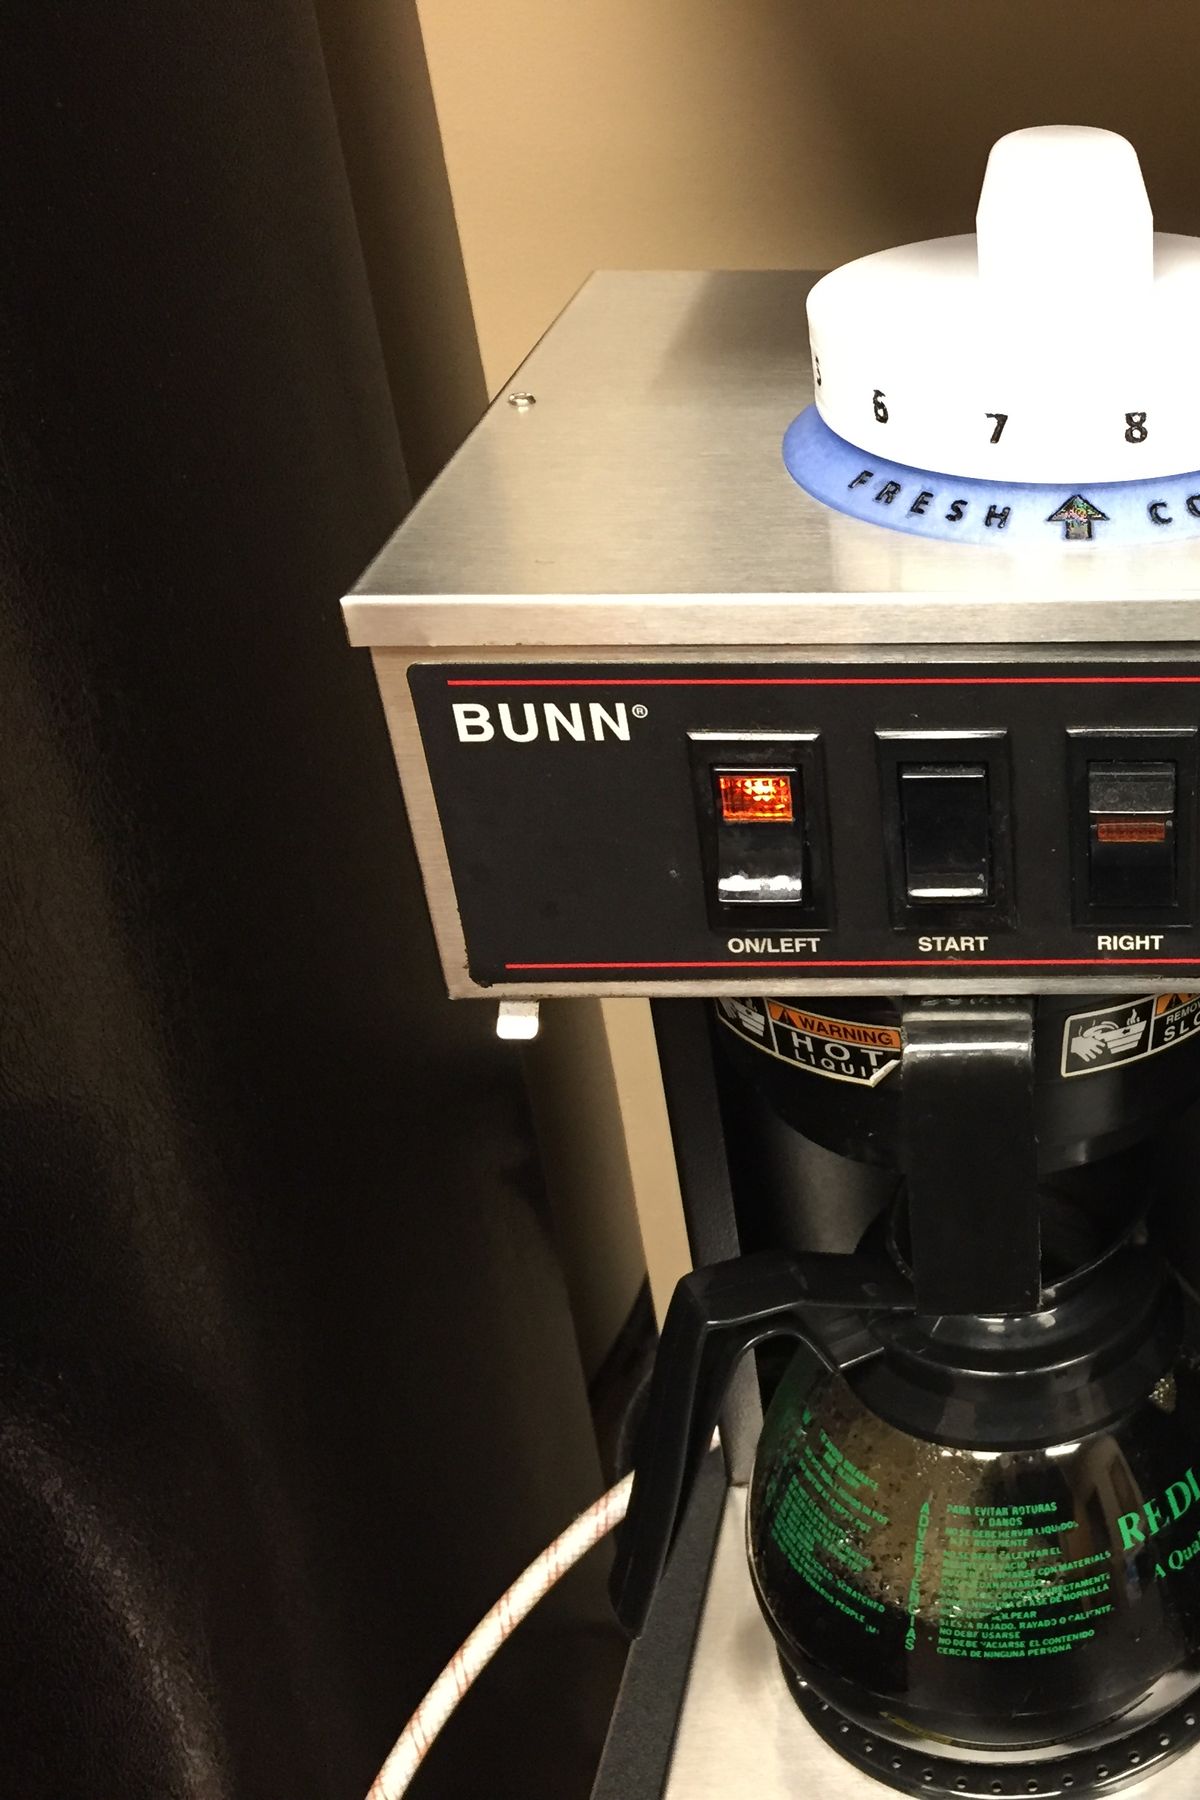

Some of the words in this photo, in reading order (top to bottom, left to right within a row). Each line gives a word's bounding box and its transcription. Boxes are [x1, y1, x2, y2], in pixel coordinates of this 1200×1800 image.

[872, 389, 889, 424] 6
[984, 412, 1009, 444] 7
[1125, 412, 1148, 444] 8
[847, 470, 1012, 529] FRESH
[727, 936, 820, 955] ON/LEFT
[917, 936, 989, 954] START
[1095, 935, 1165, 953] RIGHT
[798, 1015, 893, 1046] WARNING
[791, 1031, 883, 1066] HOT
[974, 1506, 1009, 1516] EVITAR
[1011, 1502, 1058, 1516] ROTURAS
[1038, 1565, 1057, 1577] CON
[1154, 1562, 1166, 1580] A
[836, 1580, 886, 1613] SCRATCHED
[835, 1600, 865, 1623] PEOPLE
[1019, 1617, 1057, 1630] RAYADO
[938, 1637, 952, 1646] NO
[1029, 1639, 1041, 1648] EL
[1042, 1629, 1095, 1646] CONTENIDO
[939, 1627, 953, 1637] NO
[981, 1631, 1021, 1640] USARSE
[936, 1647, 968, 1657] CERCA
[969, 1648, 982, 1658] DE
[983, 1649, 1026, 1659] NINGUNA
[1027, 1643, 1072, 1657] PERSONA
